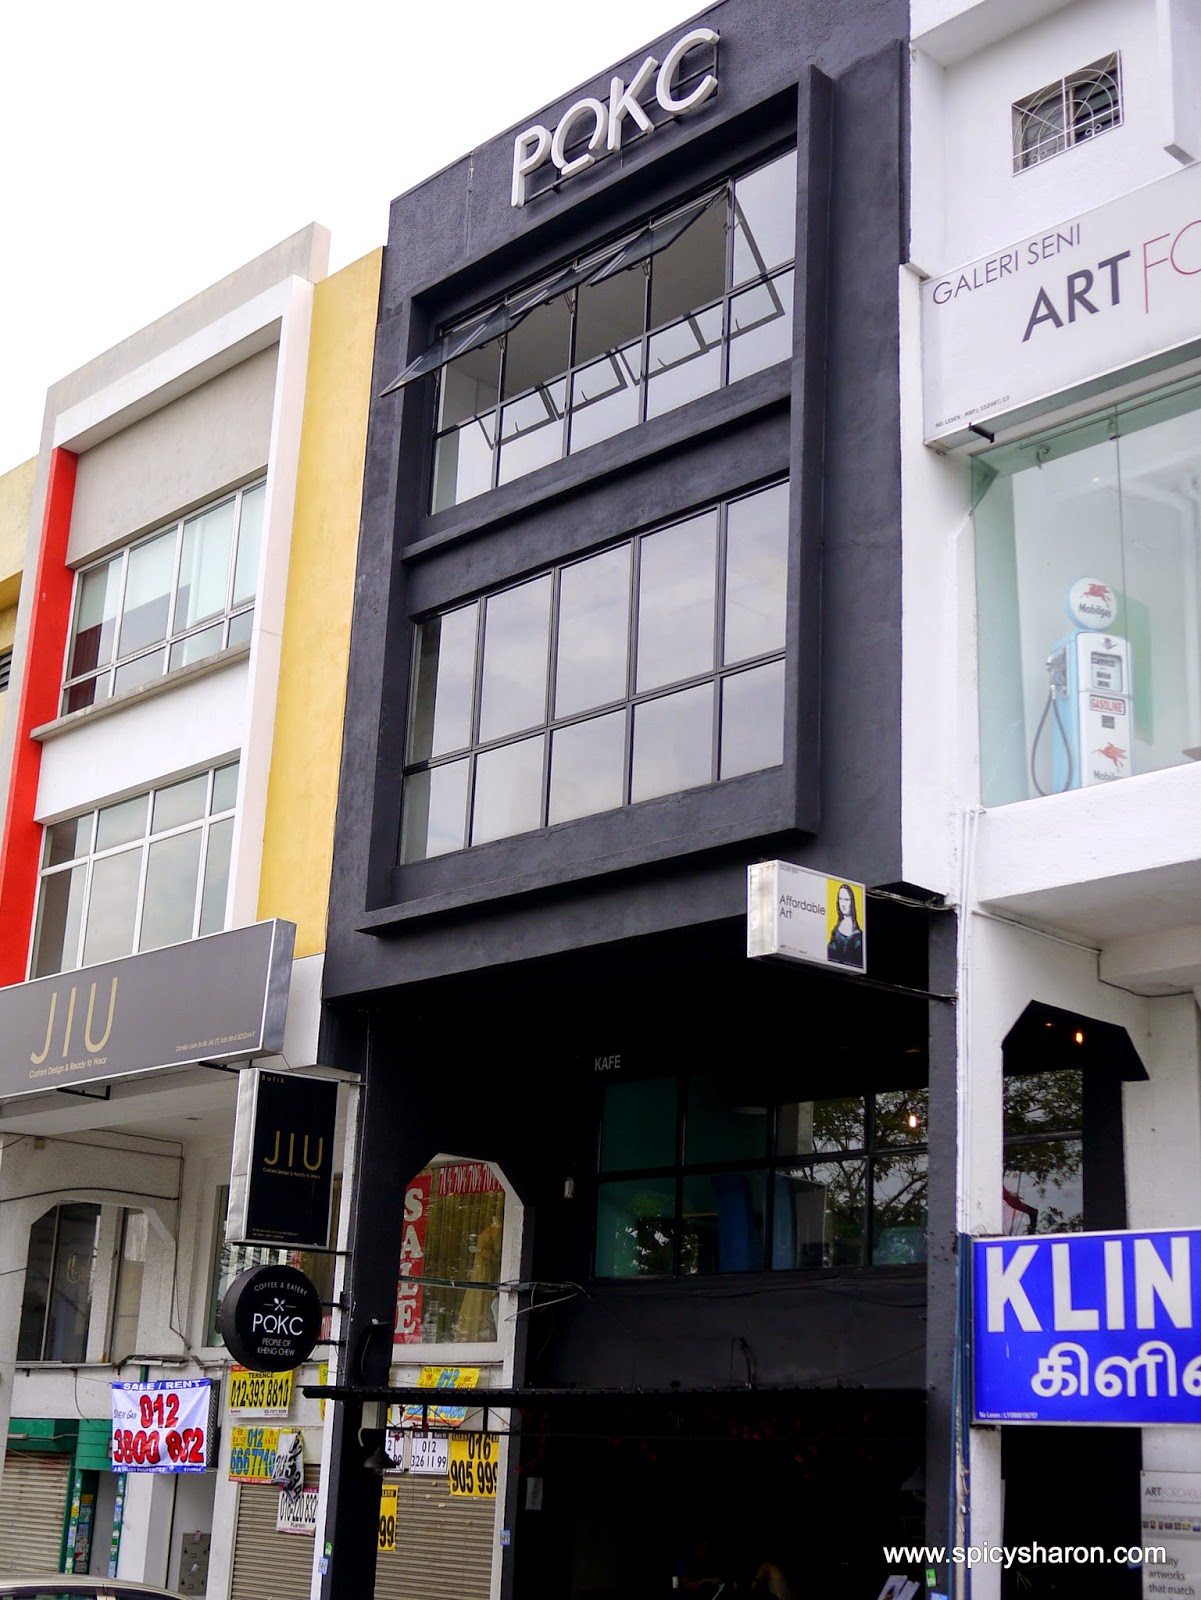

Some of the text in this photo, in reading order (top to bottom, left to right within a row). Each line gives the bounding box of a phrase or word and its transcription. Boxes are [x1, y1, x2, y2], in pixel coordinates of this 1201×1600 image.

[511, 27, 721, 209] POKC
[932, 223, 1081, 305] GALERI SENI
[1079, 602, 1112, 619] Mobilgas
[1090, 697, 1123, 713] GASOLINE
[1093, 769, 1124, 781] Mobil
[779, 894, 826, 916] Affordable
[779, 907, 793, 920] Art
[29, 976, 118, 1065] JIU
[28, 1056, 108, 1079] Custom Design & Ready to Wear
[594, 1054, 621, 1071] KAFE
[263, 1130, 323, 1171] JIU
[395, 1188, 424, 1334] SALE
[254, 1281, 308, 1296] COFFEE & EATERY
[985, 1236, 1193, 1333] KLIN
[252, 1312, 304, 1336] POKC
[262, 1337, 292, 1347] PEOPLE OF
[257, 1346, 295, 1357] KHENG CHEW
[122, 1382, 155, 1391] SALE
[165, 1380, 201, 1389] RENT
[139, 1393, 180, 1429] 012
[113, 1428, 161, 1465] 3800
[247, 1428, 265, 1448] 012
[421, 1441, 437, 1453] 012
[411, 1455, 425, 1467] 326
[437, 1456, 447, 1469] 99
[450, 1459, 474, 1493] 905
[1148, 1570, 1186, 1581] artworks
[1148, 1583, 1195, 1596] that match
